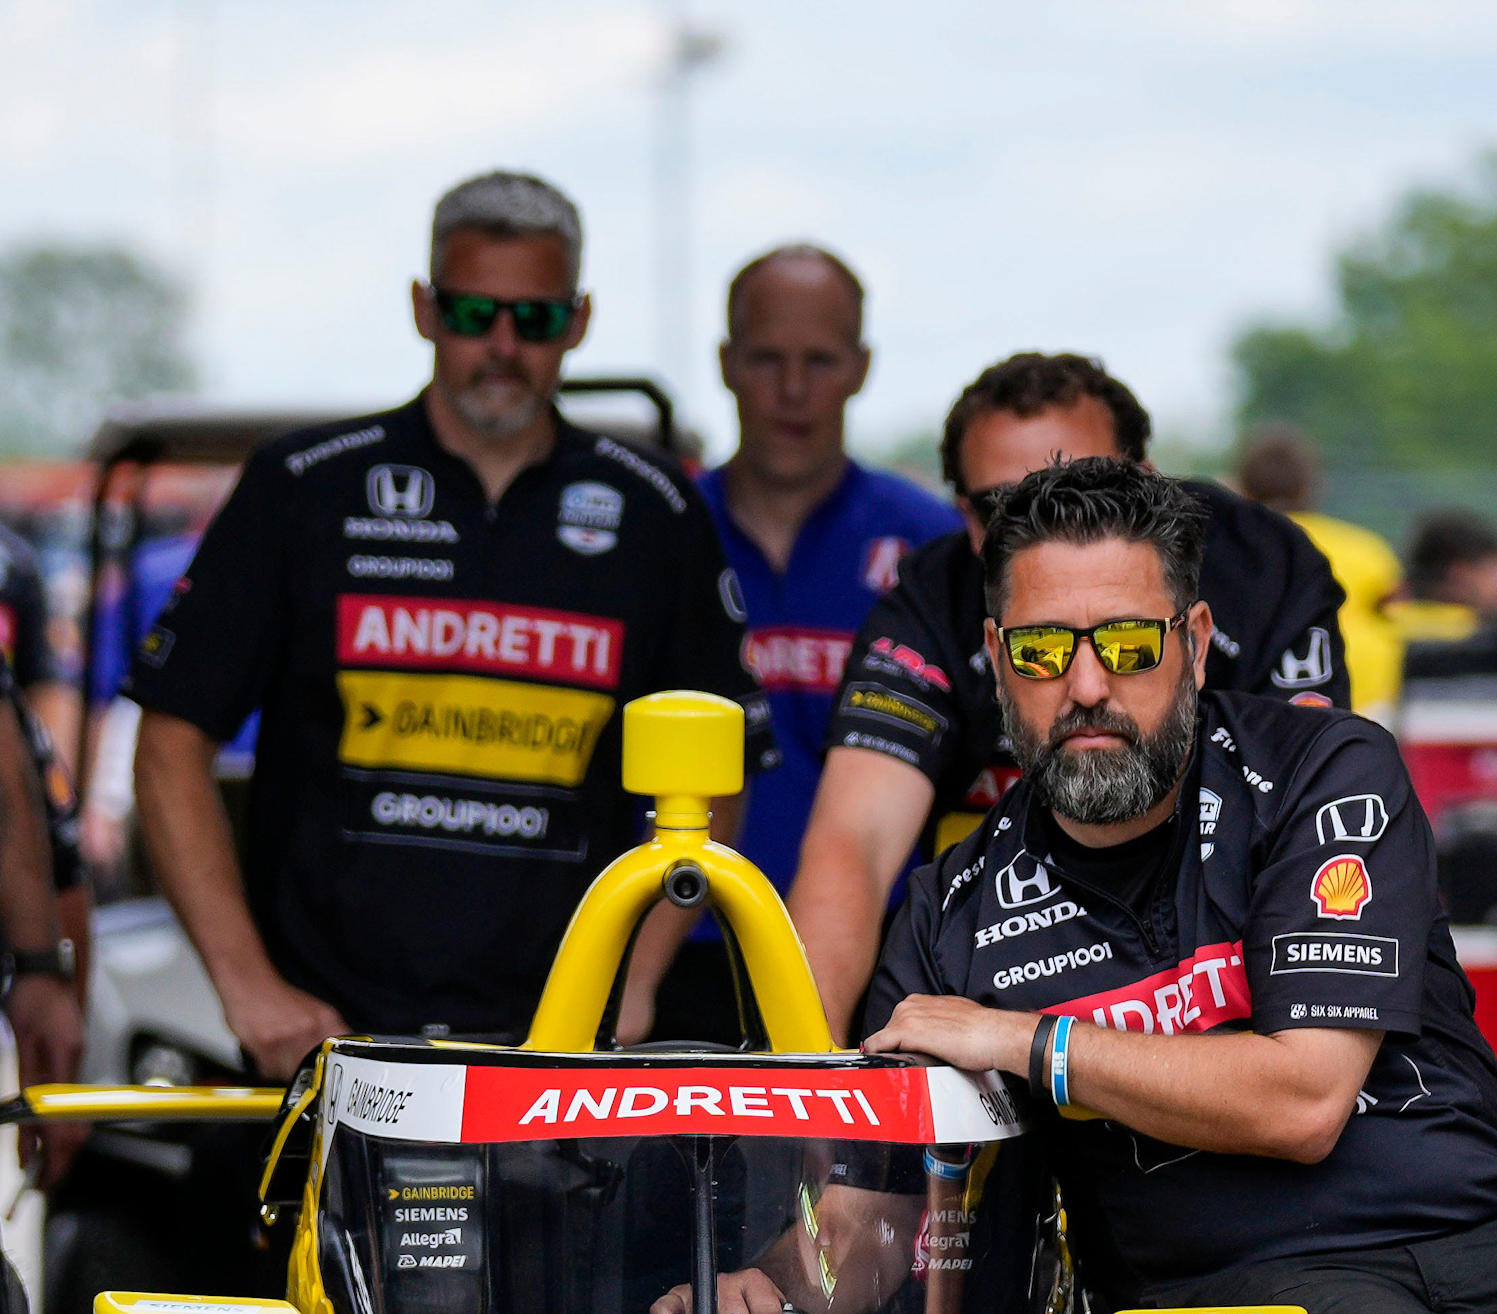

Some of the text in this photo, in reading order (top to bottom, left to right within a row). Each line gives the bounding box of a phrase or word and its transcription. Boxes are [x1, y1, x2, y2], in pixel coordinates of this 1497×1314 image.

[354, 605, 611, 676] ANDRETTI
[371, 792, 549, 838] GROUP1001
[1287, 943, 1382, 966] SIEMENS
[993, 942, 1113, 990] GROUP1001
[1311, 1005, 1325, 1017] SIX
[1327, 1005, 1342, 1018] SIX
[1344, 1006, 1379, 1020] APPAREL
[347, 1078, 413, 1124] GAINBRIDGE
[519, 1086, 881, 1126] ANDRETTI
[402, 1186, 474, 1200] GAINBRIDGE
[394, 1207, 468, 1222] SIEMENS
[400, 1232, 458, 1248] Allegra
[419, 1255, 467, 1268] MAPEI
[928, 1259, 973, 1270] MAPEI
[149, 1303, 244, 1312] SIEMENS
